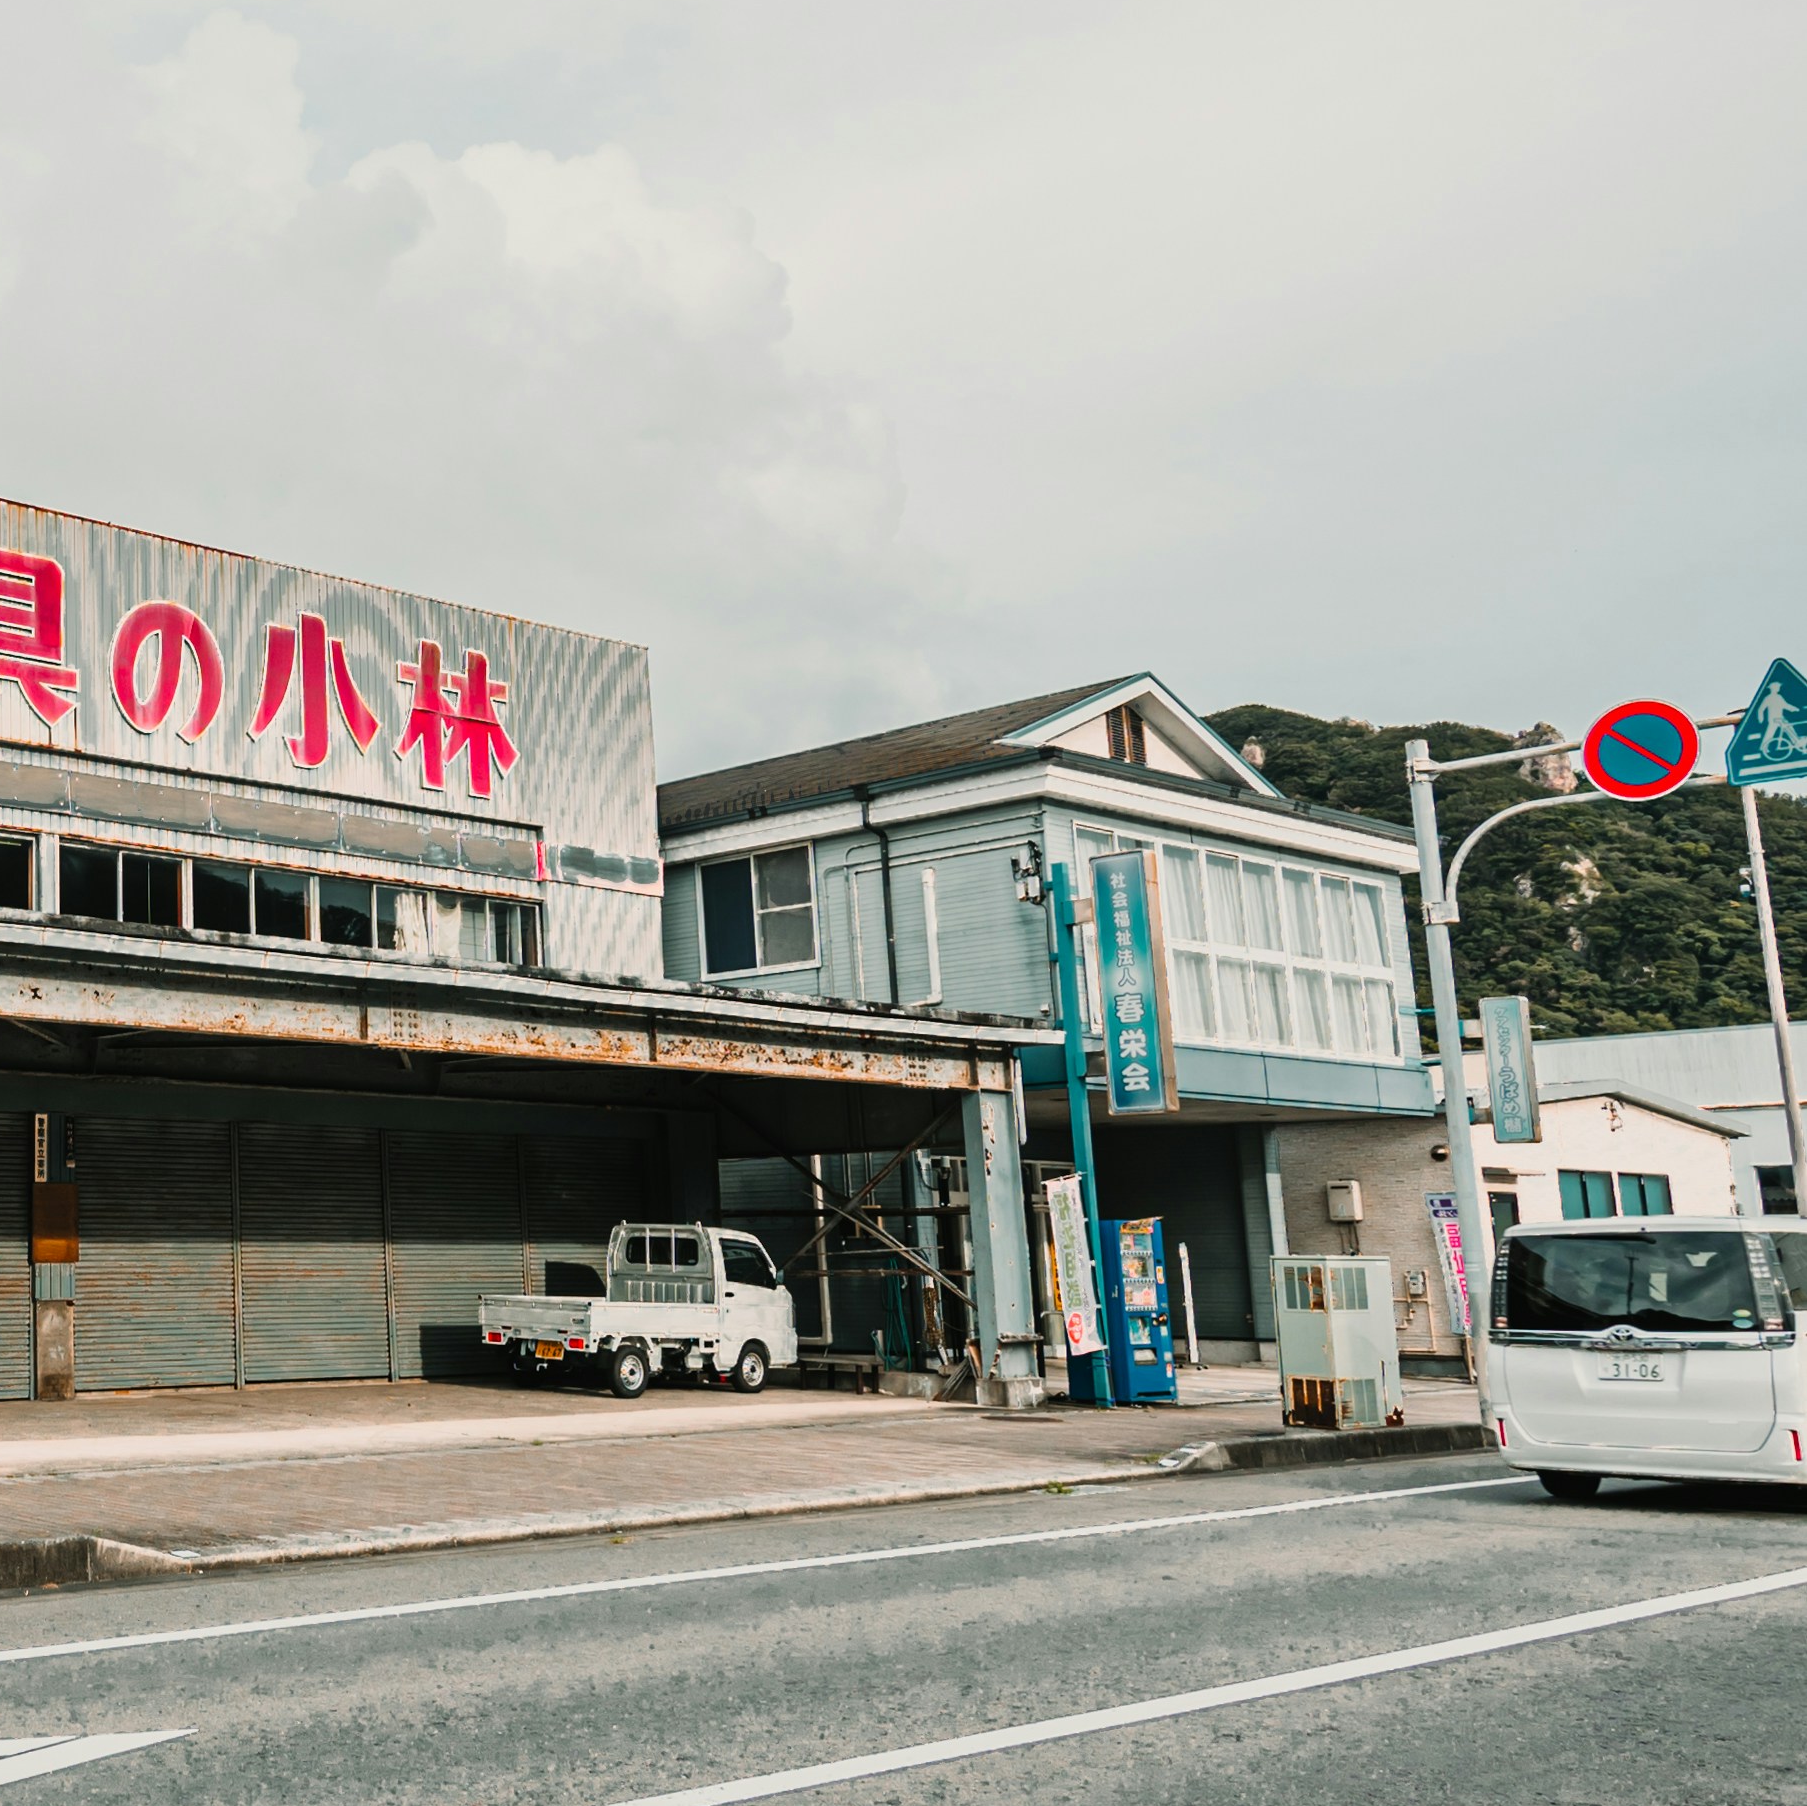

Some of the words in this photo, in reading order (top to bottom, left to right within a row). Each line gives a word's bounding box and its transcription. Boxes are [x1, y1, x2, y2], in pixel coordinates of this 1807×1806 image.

[1109, 872, 1151, 1092] 社会福祉法人春栄会
[1612, 1363, 1660, 1378] 31-06
